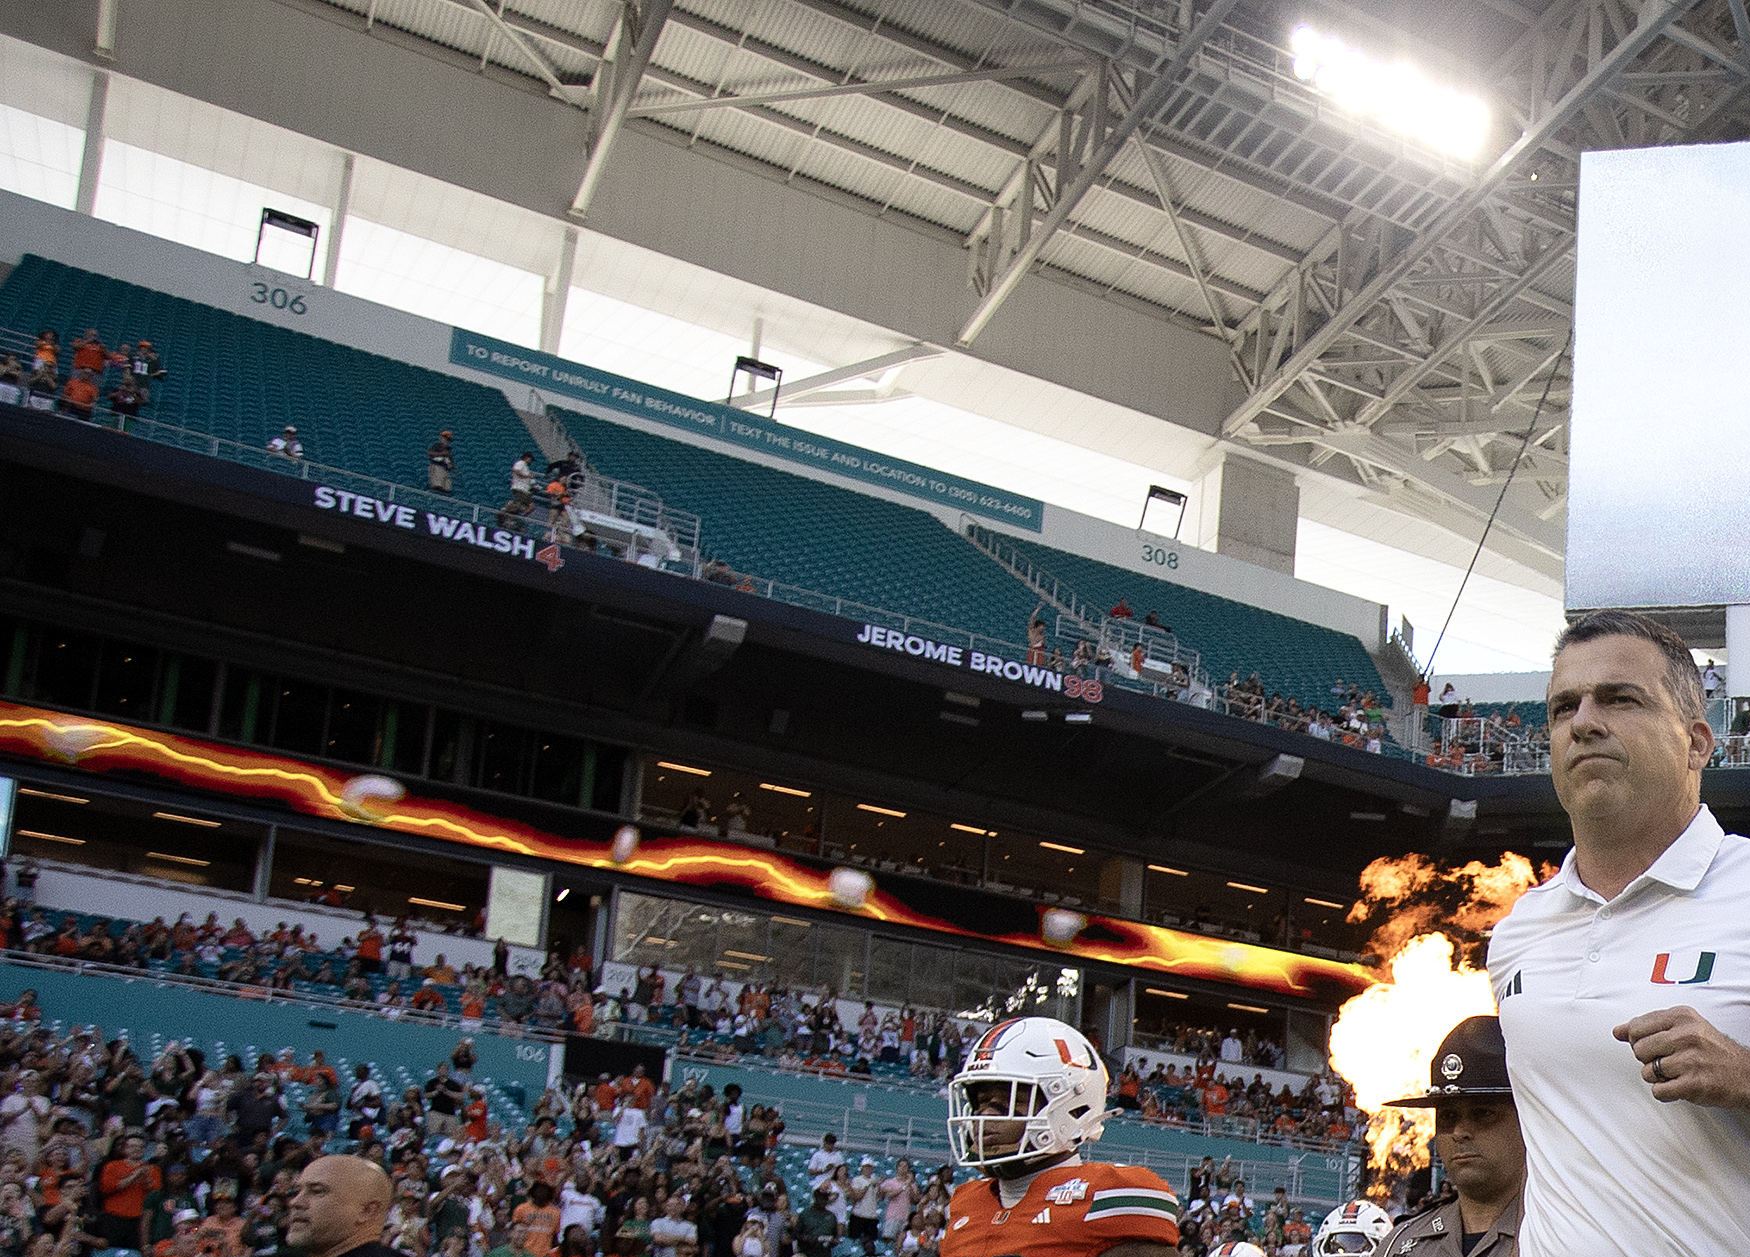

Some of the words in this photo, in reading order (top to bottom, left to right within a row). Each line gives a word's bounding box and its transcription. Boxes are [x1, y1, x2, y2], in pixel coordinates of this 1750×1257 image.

[251, 281, 307, 315] 306
[466, 344, 488, 359] TO
[490, 352, 550, 378] REPORT
[552, 369, 612, 395] UNRULY
[612, 386, 643, 405] FAN
[645, 396, 717, 427] BEHAVIOR
[730, 420, 762, 441] TEXT
[765, 430, 792, 447] THE
[792, 438, 830, 459] ISSUE
[831, 450, 862, 469] AND
[862, 460, 927, 489] LOCATION
[927, 478, 947, 494] TO
[313, 486, 416, 530] STEVE
[426, 512, 536, 560] WALSH
[536, 544, 566, 572] 4
[1140, 544, 1180, 571] 308
[856, 624, 964, 667] JEROME
[970, 651, 1063, 692] BROWN
[1063, 674, 1104, 704] 98
[1649, 950, 1718, 986] U
[515, 1044, 547, 1063] 106
[966, 1062, 991, 1072] MIAMI
